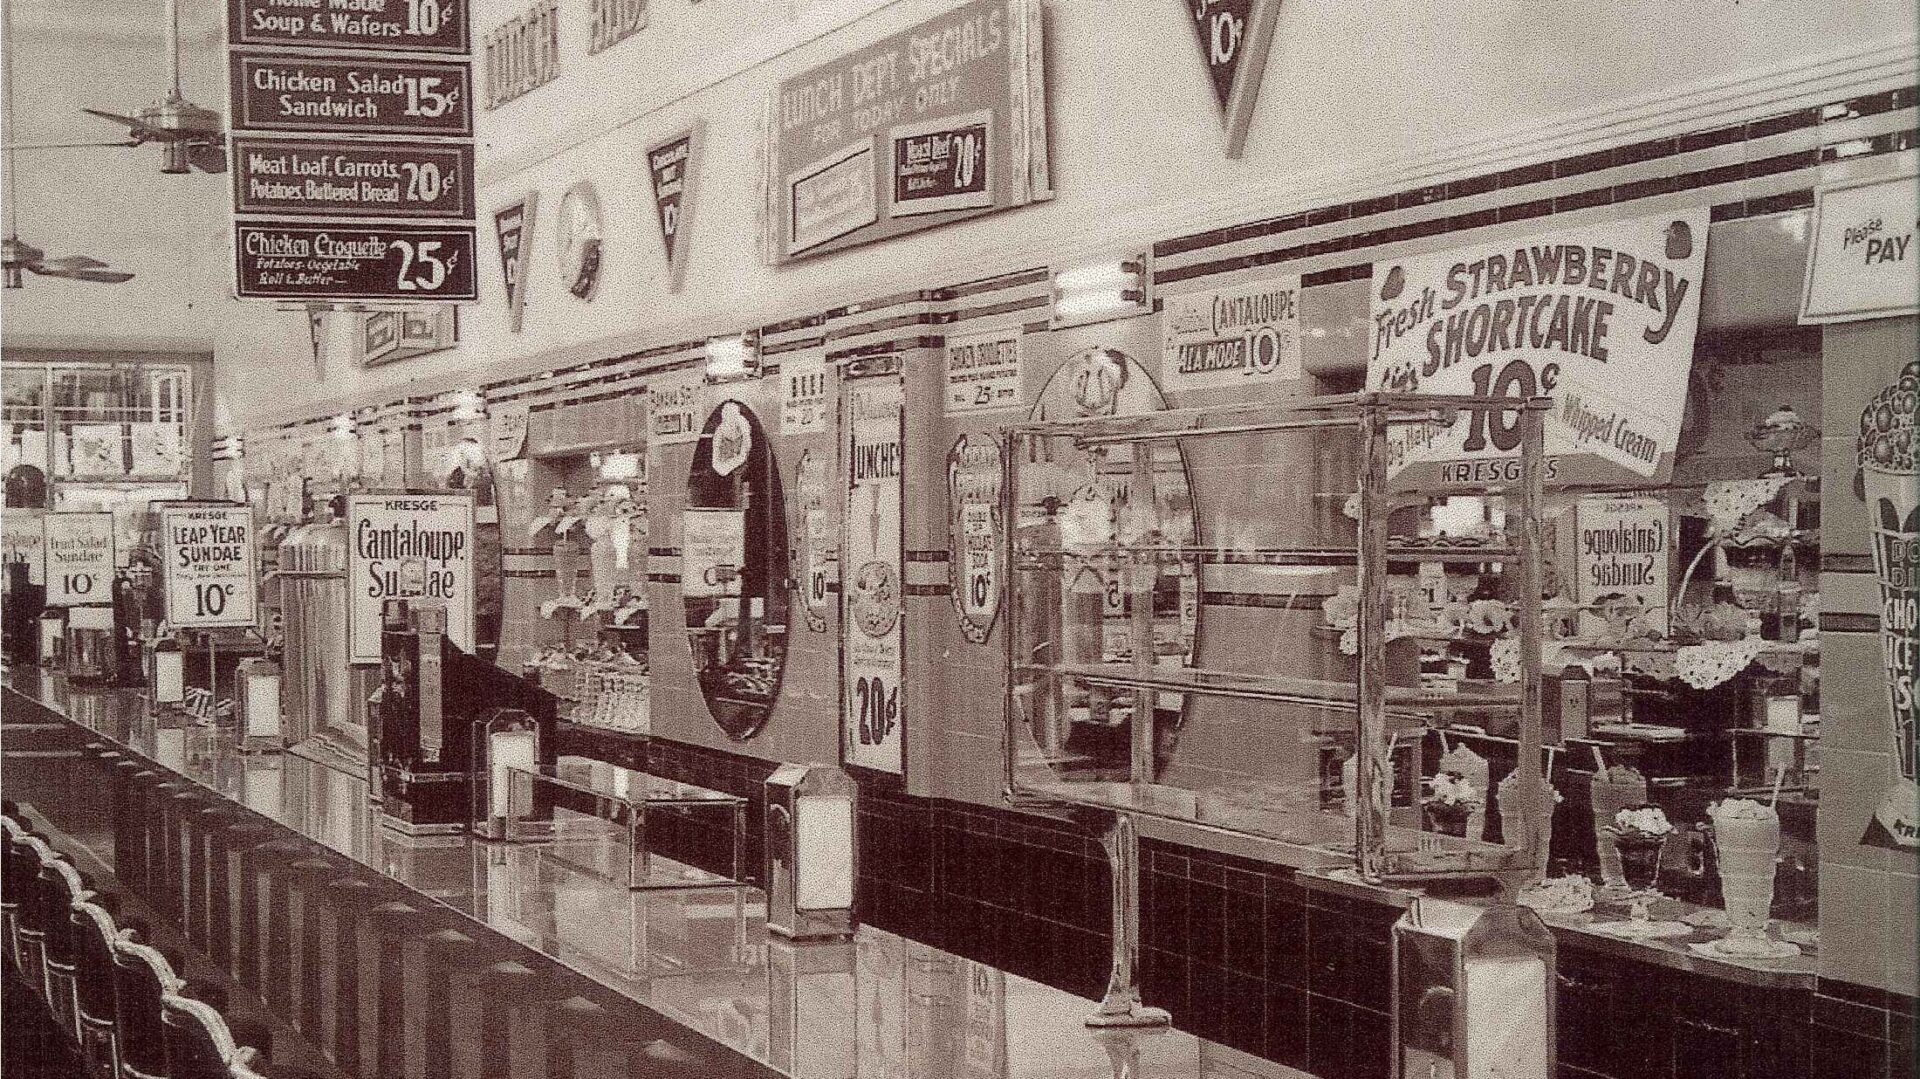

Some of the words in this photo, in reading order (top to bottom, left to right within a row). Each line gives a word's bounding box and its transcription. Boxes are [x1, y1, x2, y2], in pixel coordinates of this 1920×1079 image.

[252, 9, 304, 35] Soup
[310, 13, 326, 33] &
[331, 14, 401, 37] Wafers
[254, 68, 336, 92] Chicken
[347, 72, 403, 95] Salad
[783, 73, 843, 130] LUNCH
[907, 9, 1002, 82] SPECIALS
[279, 95, 377, 119] Sandwich
[250, 153, 286, 175] Meat
[305, 180, 358, 201] Buttered
[362, 181, 399, 202] Bread
[246, 231, 310, 256] Chicken
[1842, 217, 1883, 250] Please
[389, 240, 458, 290] 25¢
[1865, 233, 1912, 266] PAY
[1442, 244, 1689, 345] STRAWBERRY
[1211, 288, 1295, 336] CANTALOUPE
[1373, 286, 1436, 361] Fresh
[1422, 294, 1614, 378] SHORTCAKE
[1205, 341, 1242, 370] MODE
[1561, 392, 1616, 445] Whipped
[1614, 417, 1658, 464] Cream
[385, 499, 438, 512] KRESGE
[173, 525, 208, 546] LEAP
[209, 524, 247, 545] YEAR
[55, 549, 104, 564] Sundae
[178, 545, 242, 569] SUNDAE
[368, 560, 455, 599] Suae
[856, 676, 898, 746] 20¢
